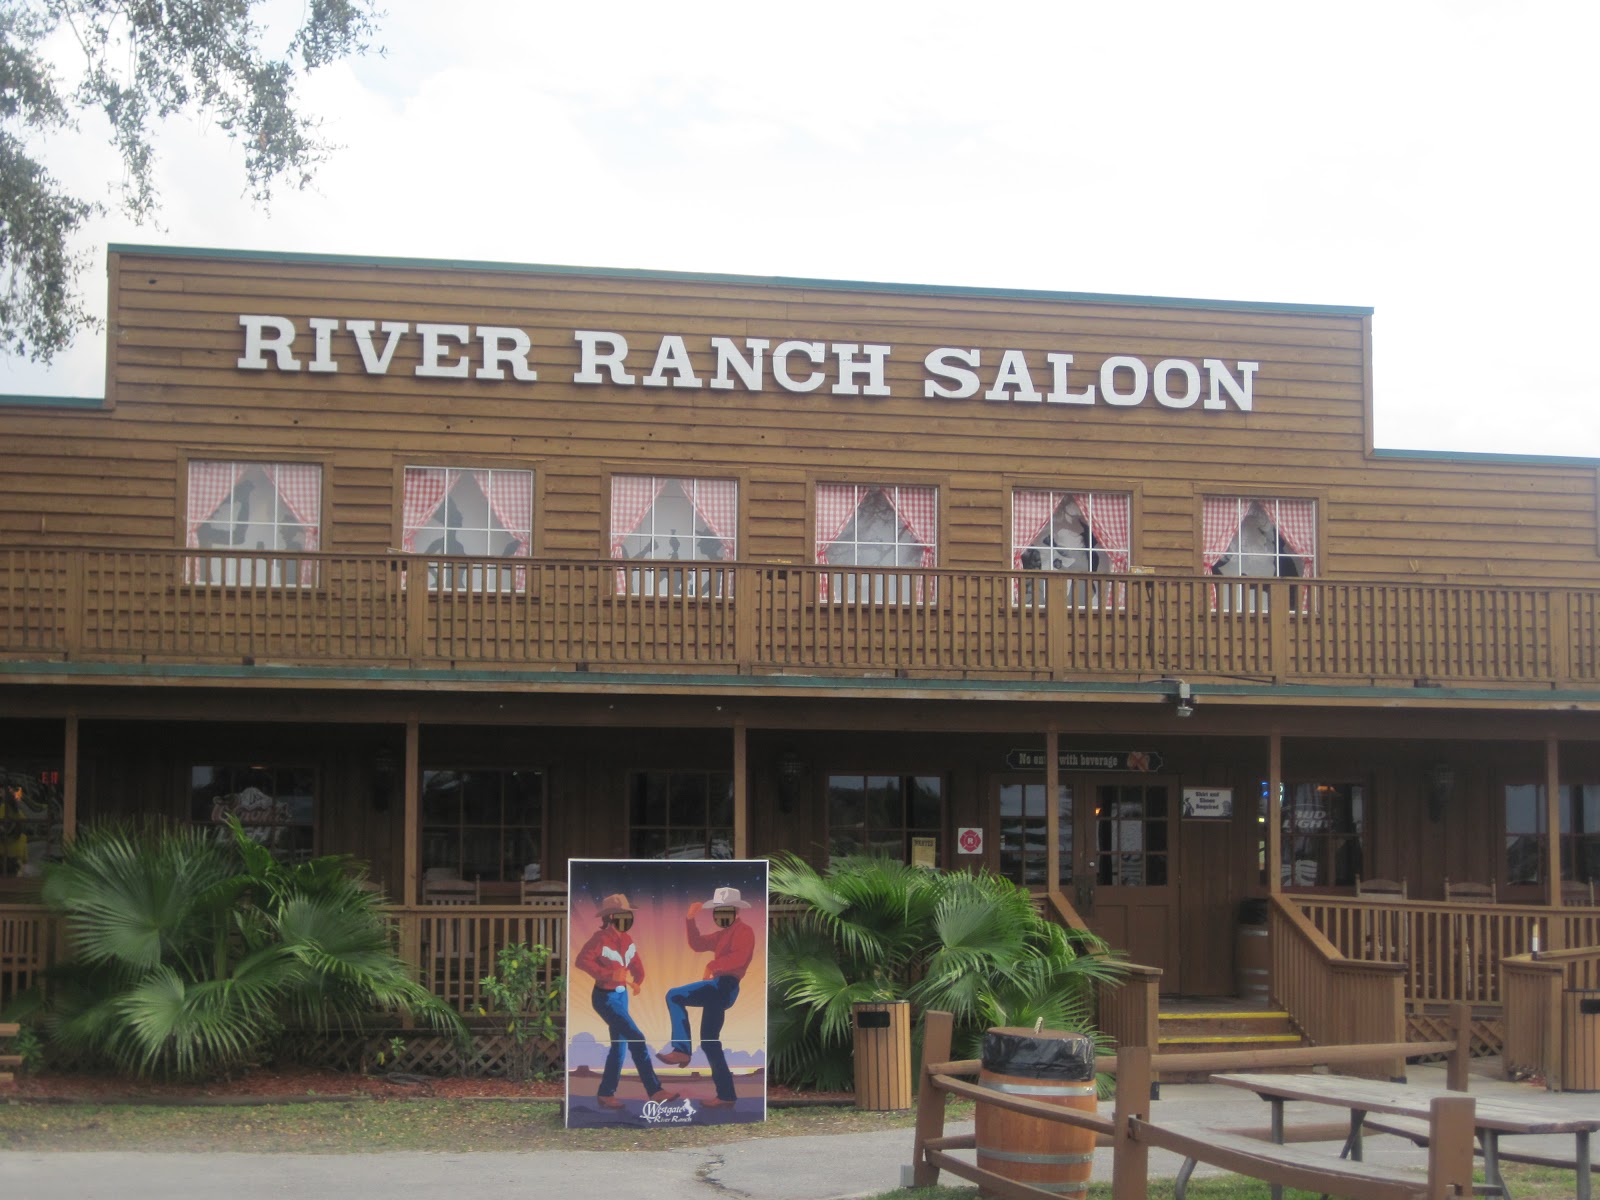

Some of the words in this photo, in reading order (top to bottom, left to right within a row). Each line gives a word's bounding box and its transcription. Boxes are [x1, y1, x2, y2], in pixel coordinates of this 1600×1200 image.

[237, 314, 538, 382] RIVER
[573, 330, 892, 396] RANCH
[924, 347, 1259, 412] SALOON
[1019, 753, 1031, 765] No
[1059, 755, 1078, 765] with
[1081, 755, 1118, 768] beverage
[641, 1099, 683, 1121] Westgate
